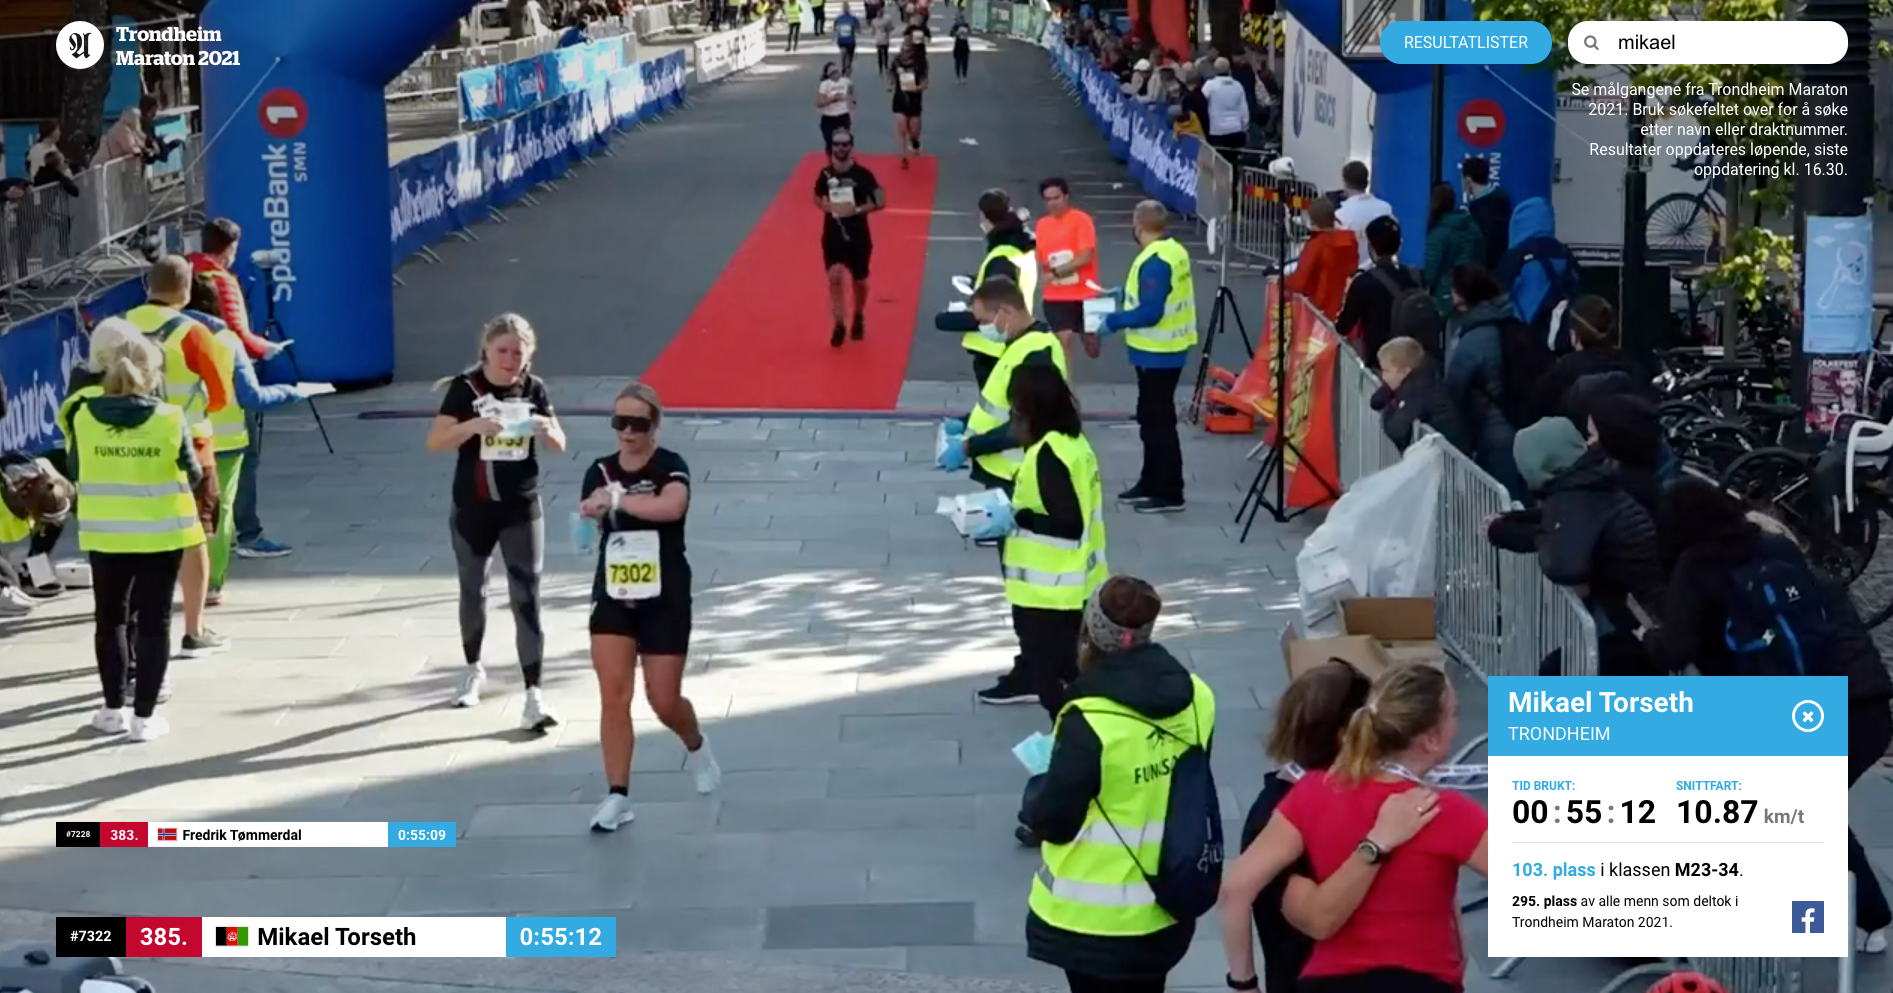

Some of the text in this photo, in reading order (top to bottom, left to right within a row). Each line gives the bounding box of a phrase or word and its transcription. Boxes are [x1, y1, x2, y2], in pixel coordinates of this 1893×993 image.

[293, 141, 308, 183] SMN
[261, 105, 299, 302] SpareBank 1
[94, 446, 161, 458] FUNKSJONÆR
[609, 563, 652, 584] 7302
